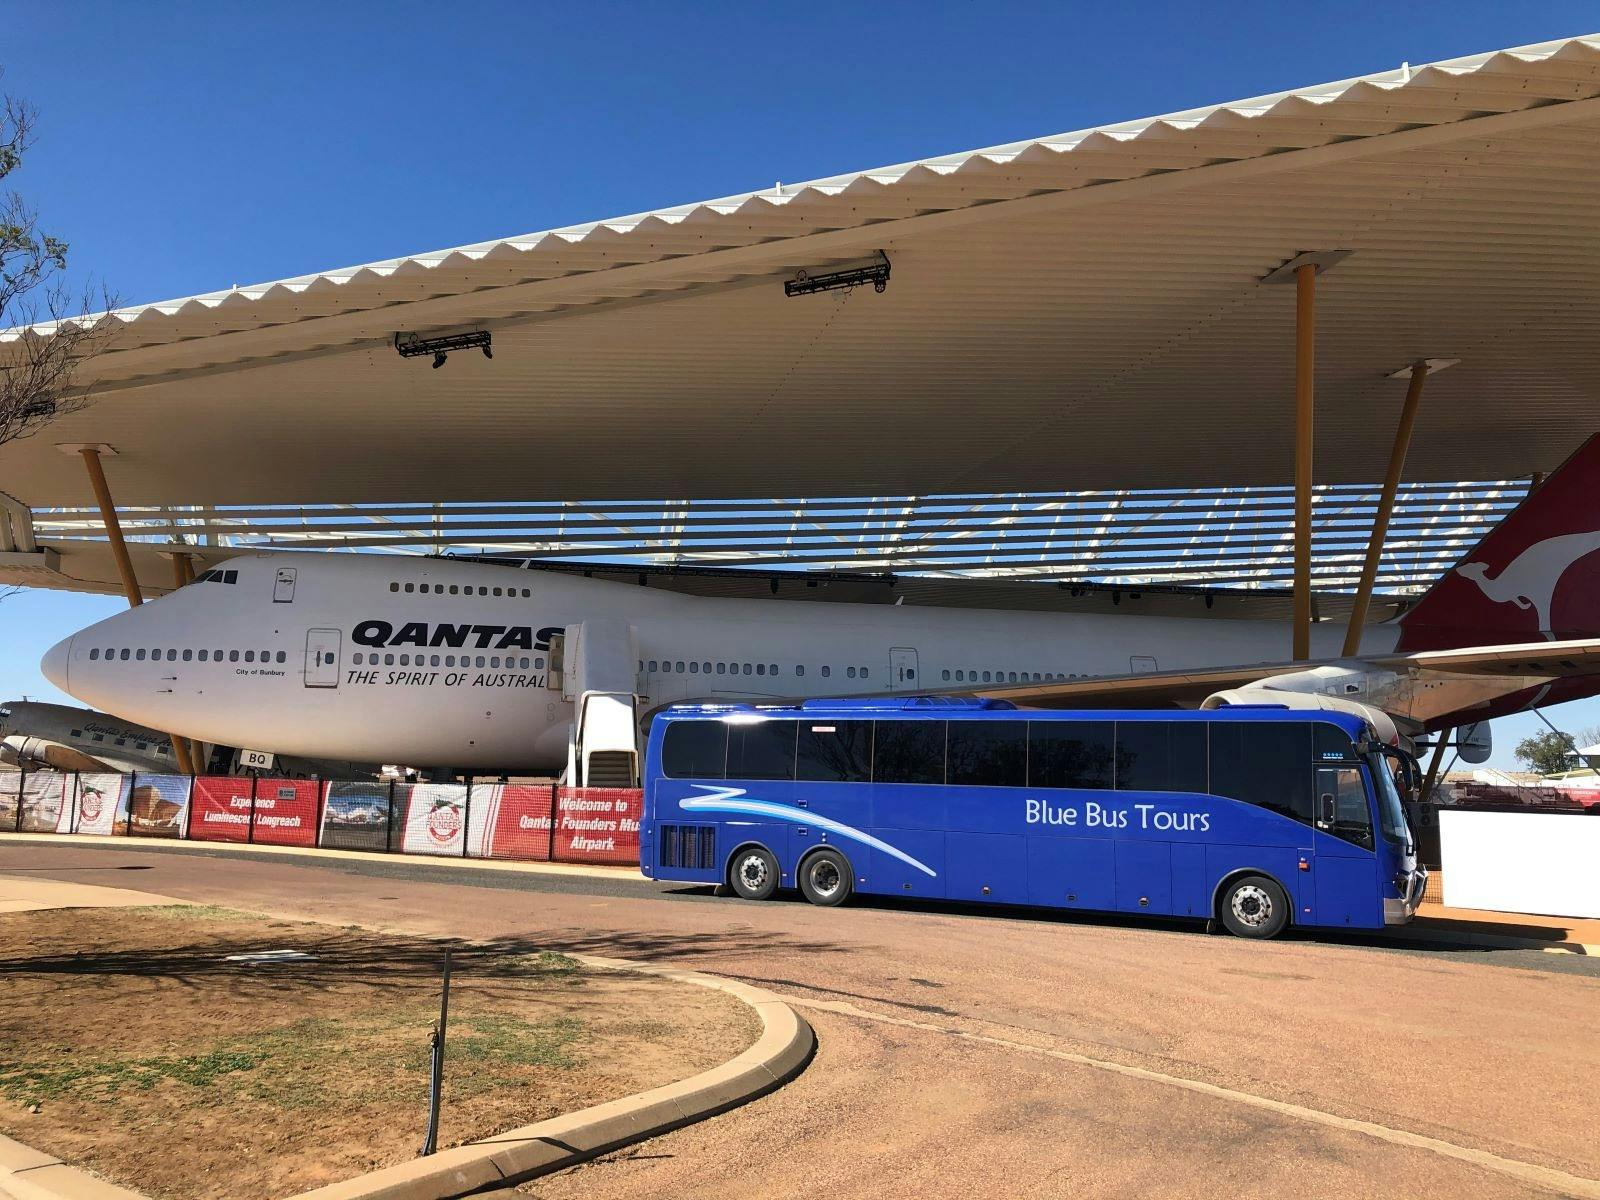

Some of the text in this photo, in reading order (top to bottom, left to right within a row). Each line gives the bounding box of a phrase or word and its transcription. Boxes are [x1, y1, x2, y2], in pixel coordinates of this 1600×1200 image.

[352, 620, 565, 651] QANTAS
[236, 668, 249, 676] City
[260, 669, 286, 677] Bunbury
[347, 671, 547, 688] THE SPIRIT OF AUSTRAL
[249, 753, 266, 765] BQ
[559, 798, 628, 812] Welcome to
[257, 814, 301, 828] Longreach
[520, 815, 558, 829] Qantas
[561, 816, 616, 831] Founders
[1026, 799, 1210, 832] Blue Bus Tours
[570, 836, 615, 852] Airpark
